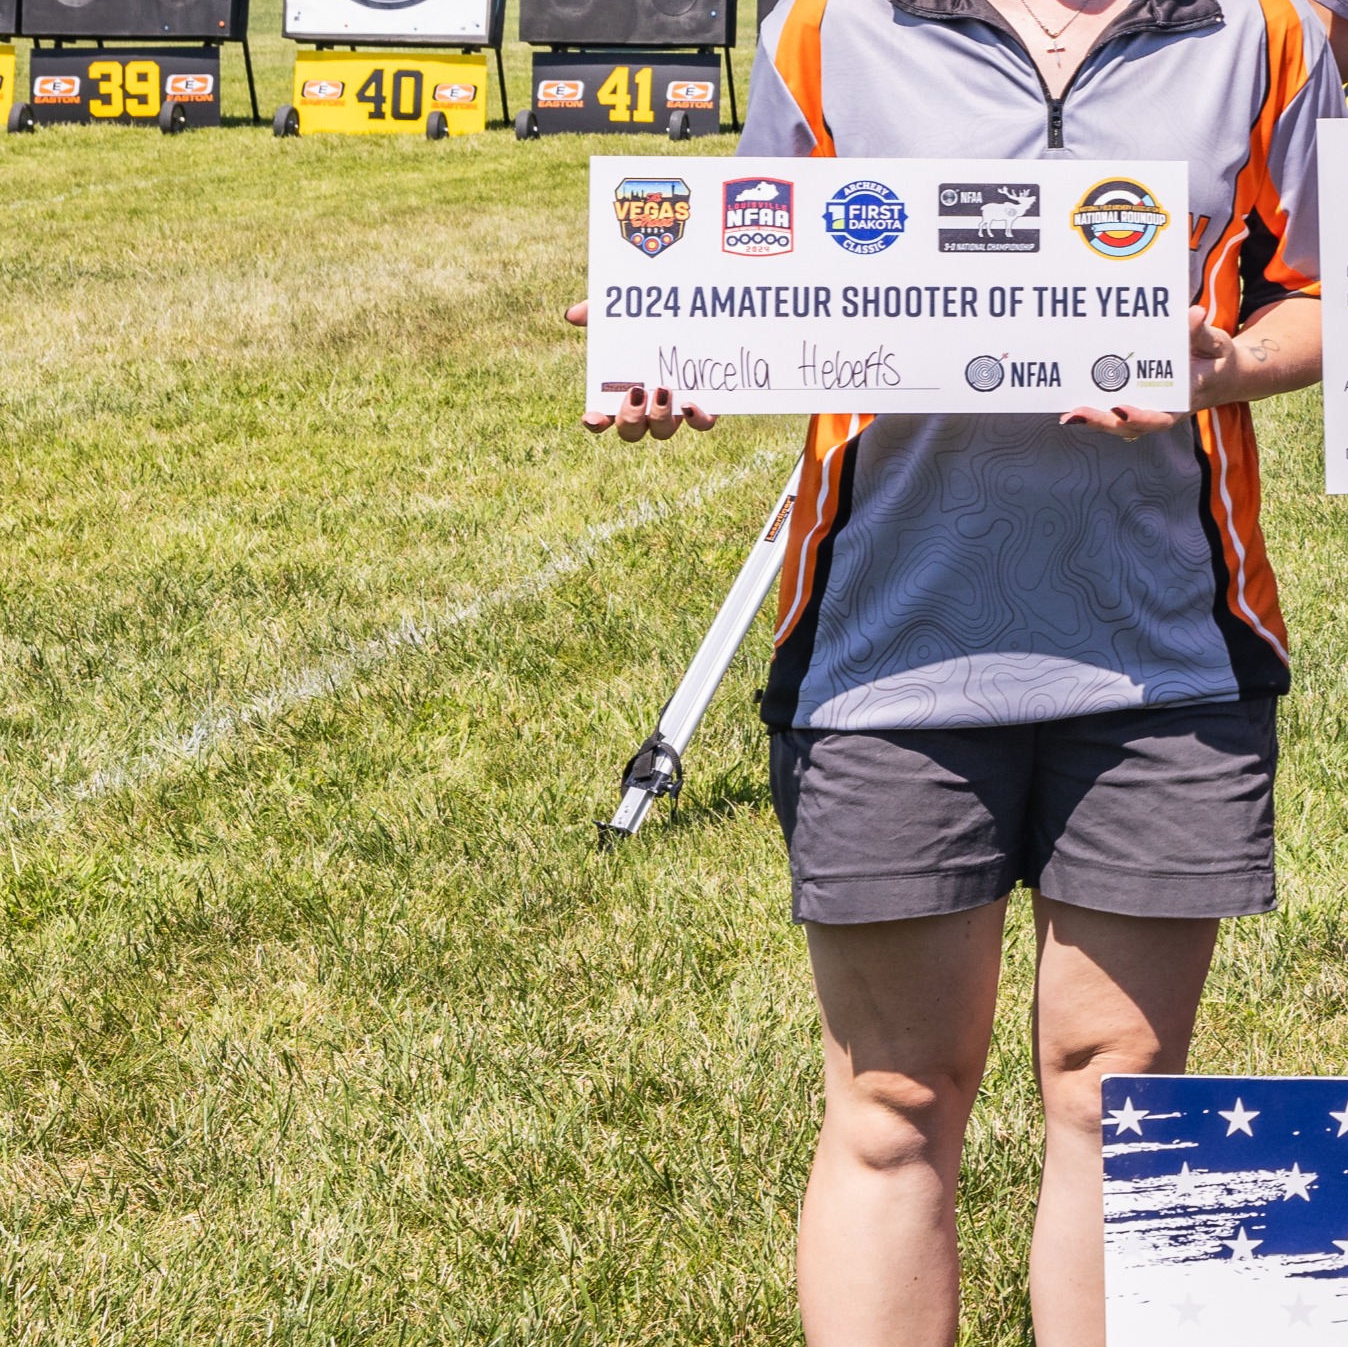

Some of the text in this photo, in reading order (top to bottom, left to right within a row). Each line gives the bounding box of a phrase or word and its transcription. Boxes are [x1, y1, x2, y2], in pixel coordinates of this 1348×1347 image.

[88, 60, 160, 118] 39
[356, 68, 424, 121] 40
[597, 66, 655, 123] 41
[34, 96, 81, 104] EASTON
[537, 100, 584, 108] EASTON
[666, 101, 714, 109] EASTON
[613, 201, 690, 221] VEGAS
[726, 208, 790, 228] NFAA
[849, 205, 901, 220] FIRST
[849, 219, 902, 230] DAKOTA
[607, 287, 1169, 318] 2024 AMATEUR SHOOTER OF THE YEAR
[659, 346, 770, 391] Marcella
[1011, 362, 1061, 387] NFAA
[1137, 360, 1174, 379] NFAA
